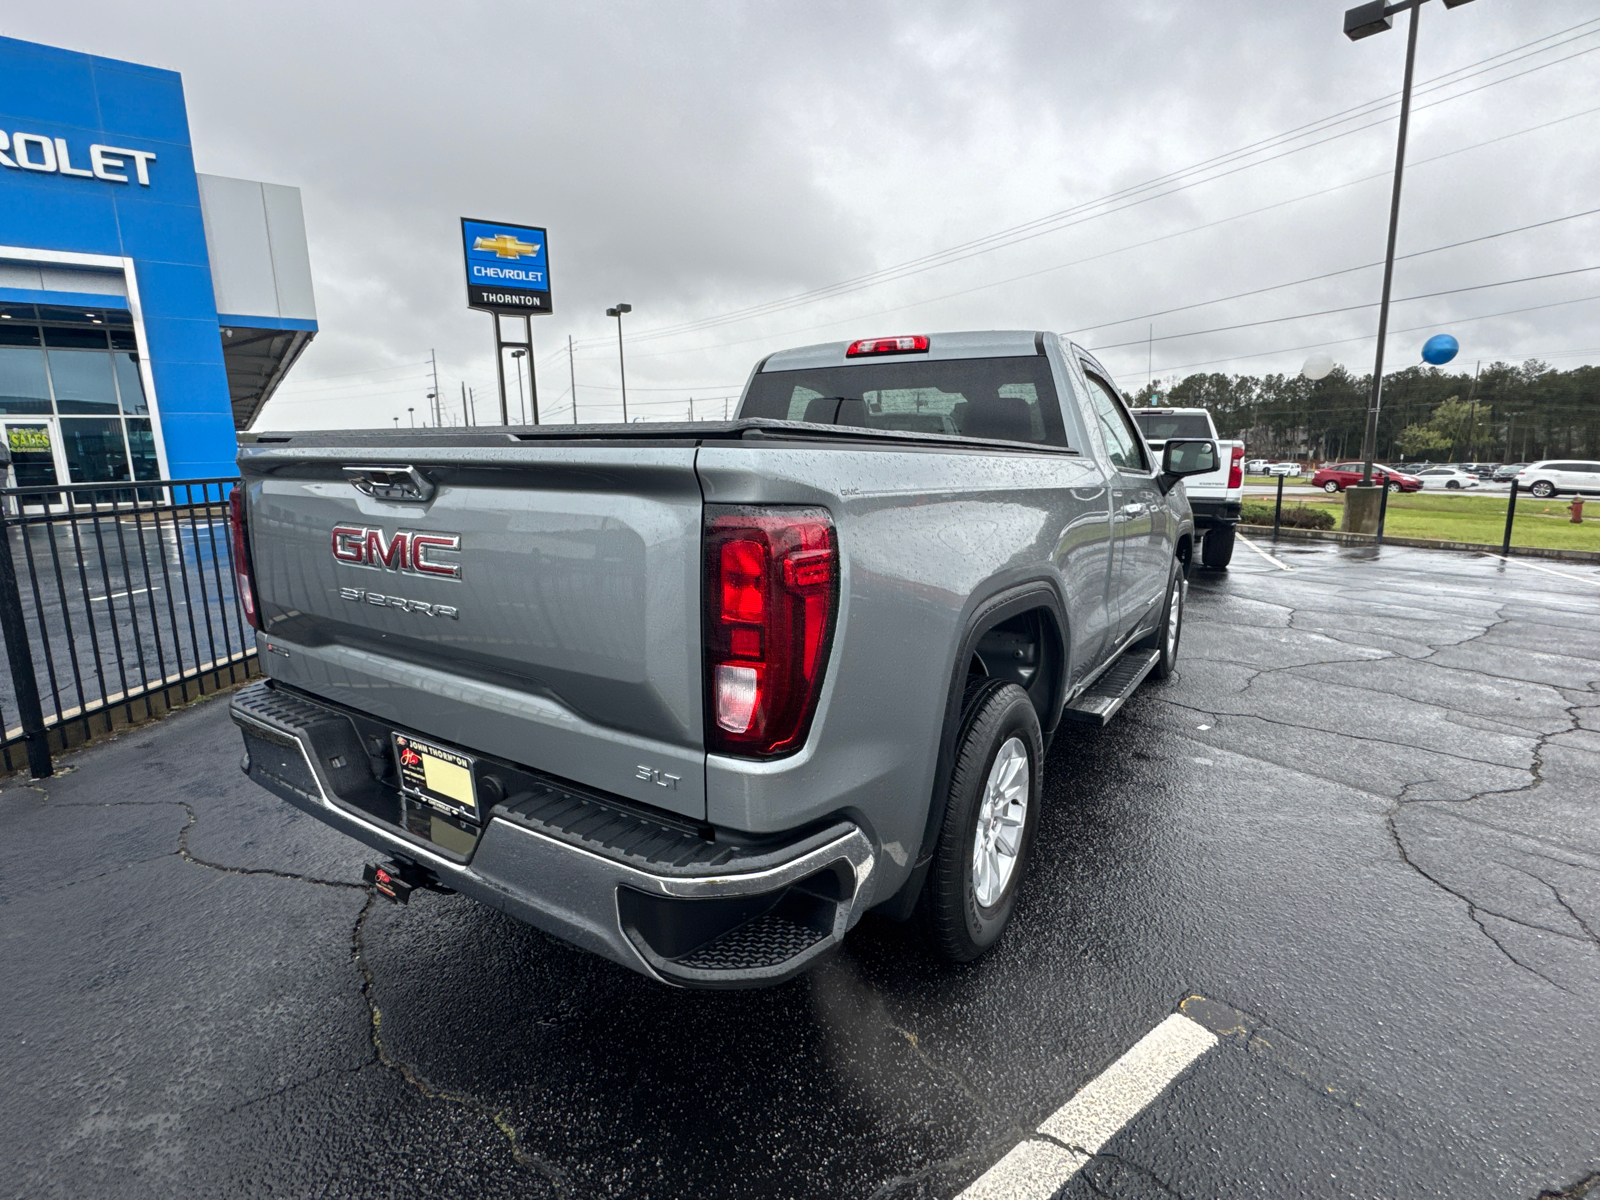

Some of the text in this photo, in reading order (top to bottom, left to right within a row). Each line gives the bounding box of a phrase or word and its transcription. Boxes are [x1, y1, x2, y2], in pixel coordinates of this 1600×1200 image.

[473, 265, 543, 282] CHEVROLET
[481, 292, 541, 306] THORNTON
[11, 434, 50, 447] SALES
[840, 488, 860, 496] GMC
[332, 523, 462, 580] GMC
[340, 587, 459, 620] SIERRA
[409, 740, 429, 754] JOHN
[429, 747, 468, 768] THORNTON
[635, 765, 682, 791] SLT
